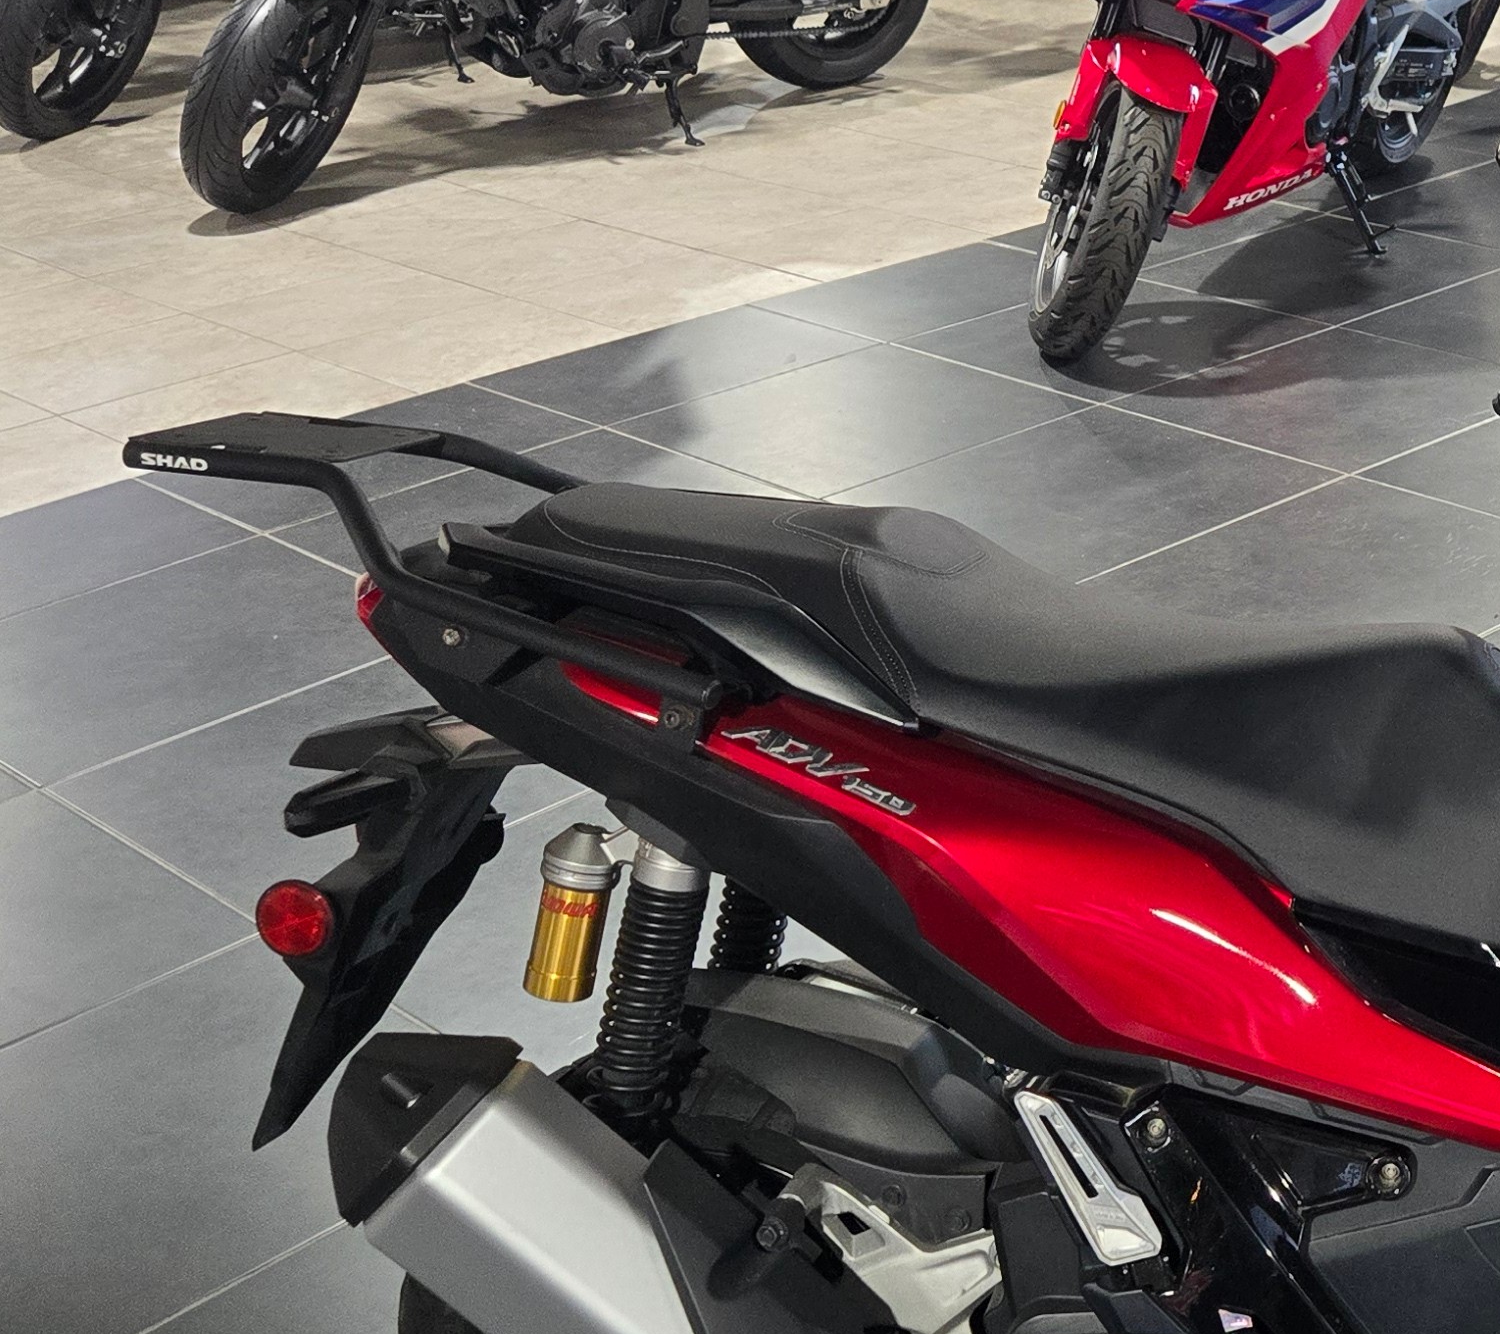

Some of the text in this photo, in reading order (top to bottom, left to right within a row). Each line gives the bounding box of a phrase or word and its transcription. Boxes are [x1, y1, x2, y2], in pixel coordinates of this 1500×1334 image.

[1223, 168, 1313, 211] HONDA
[140, 452, 208, 471] SHAD
[721, 724, 917, 816] ADV 150
